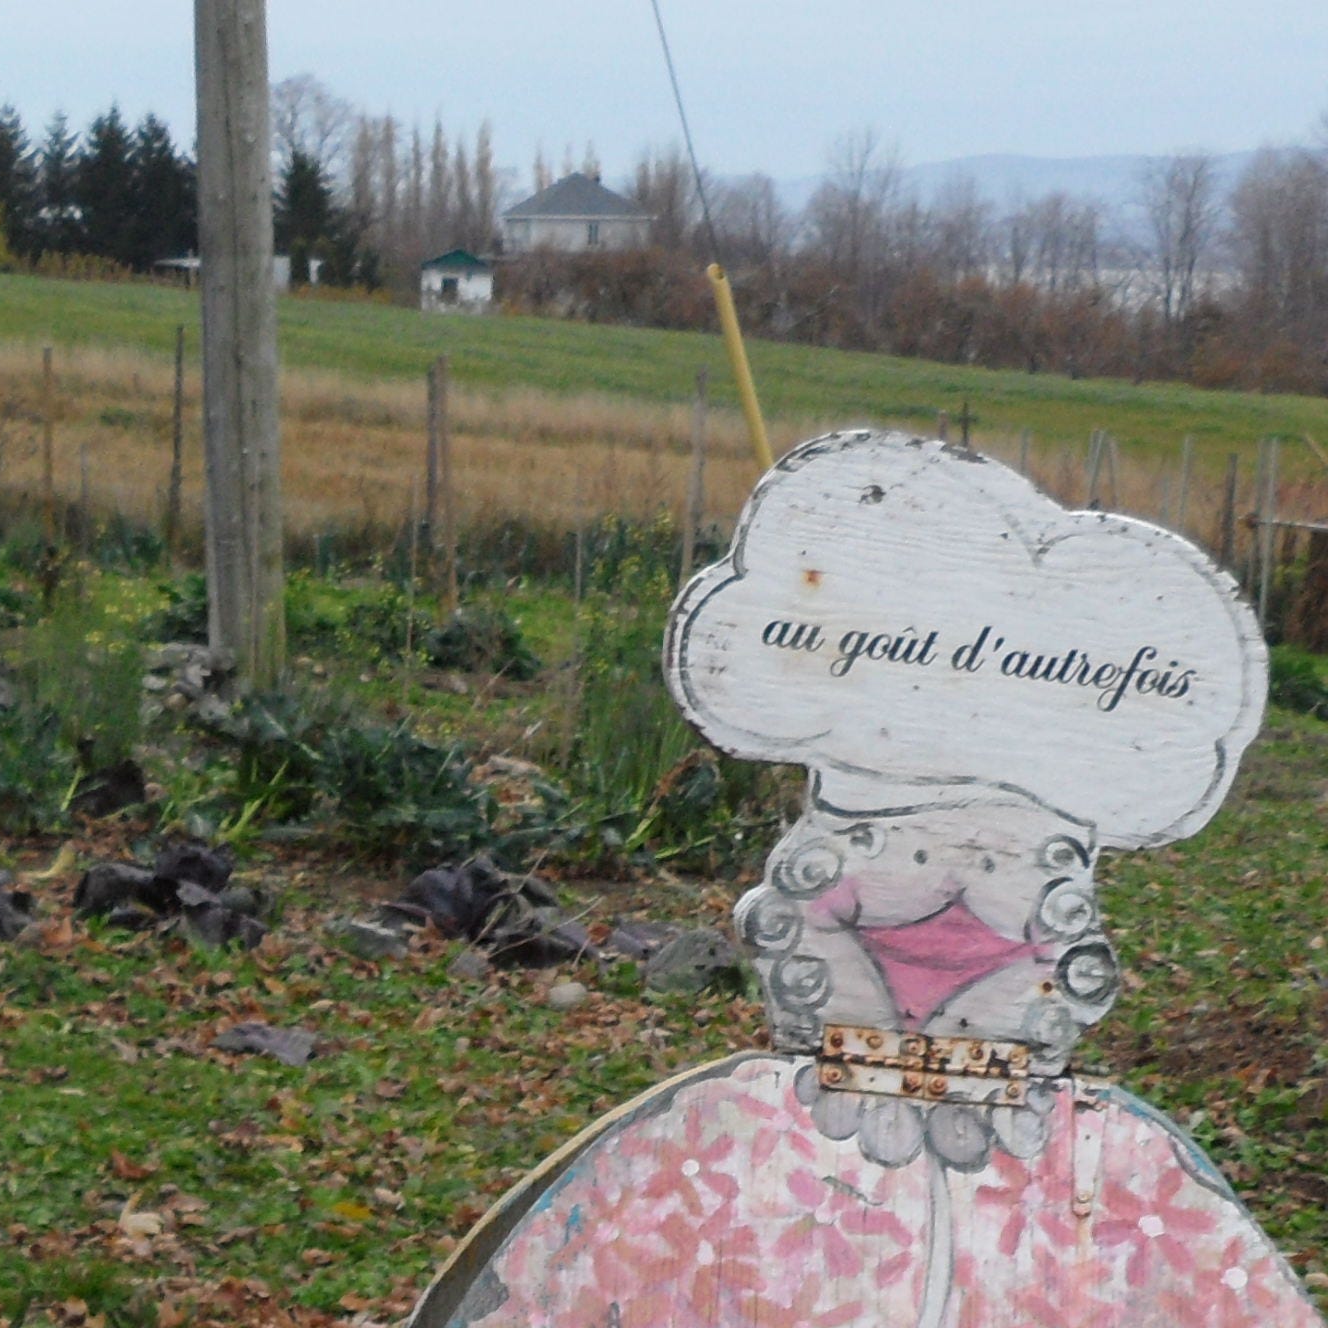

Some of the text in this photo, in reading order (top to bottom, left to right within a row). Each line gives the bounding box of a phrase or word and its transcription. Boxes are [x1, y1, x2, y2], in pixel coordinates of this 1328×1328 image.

[760, 618, 1199, 713] au goût d'autrefois
